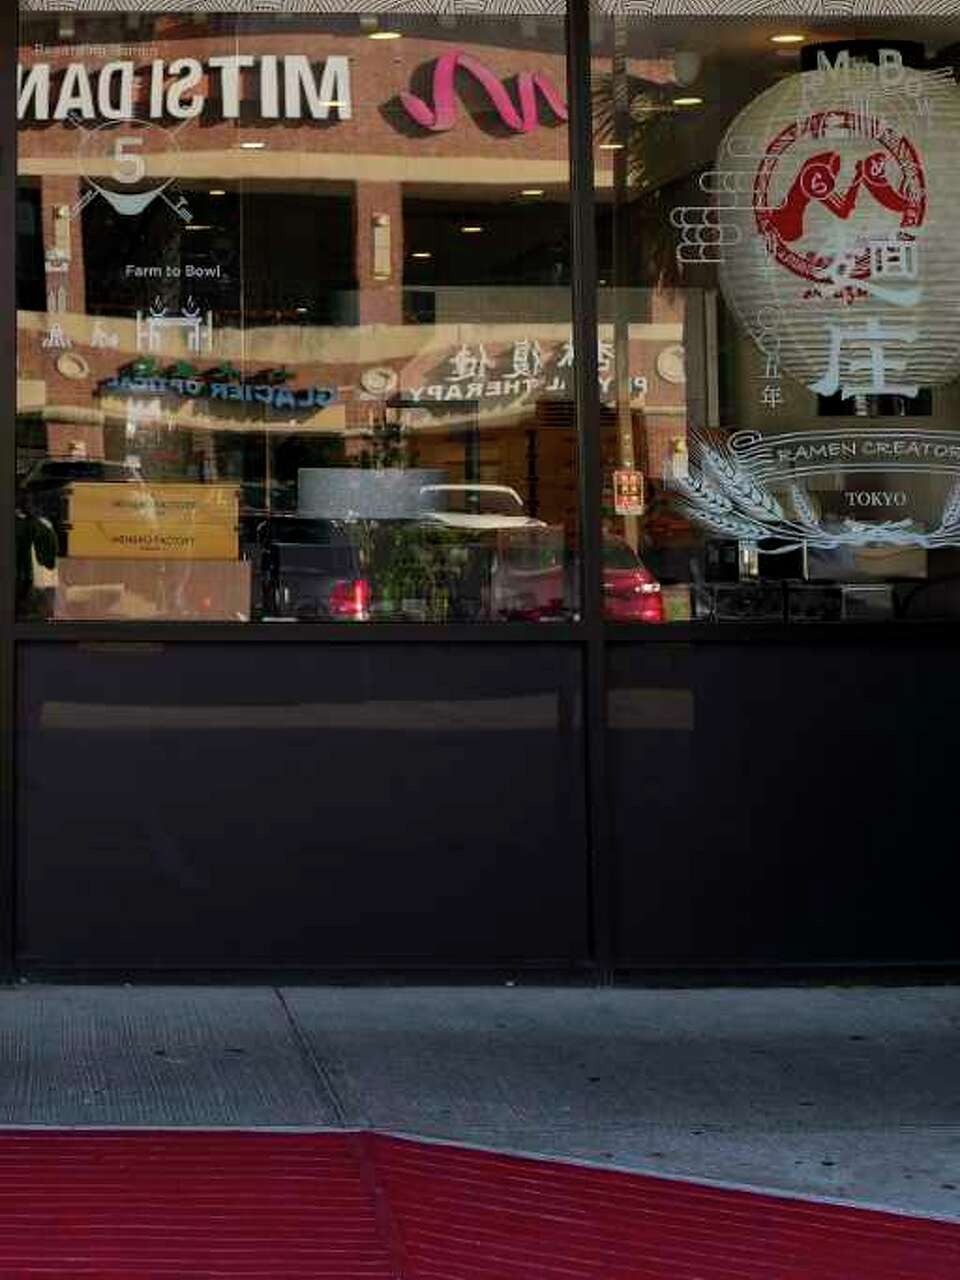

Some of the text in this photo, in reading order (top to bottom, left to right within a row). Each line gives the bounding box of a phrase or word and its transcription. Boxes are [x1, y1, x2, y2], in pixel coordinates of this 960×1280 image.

[111, 136, 146, 184] 5
[125, 265, 162, 278] Farm
[166, 265, 181, 278] to
[777, 441, 856, 462] RAMEN
[845, 491, 907, 507] TOKYO
